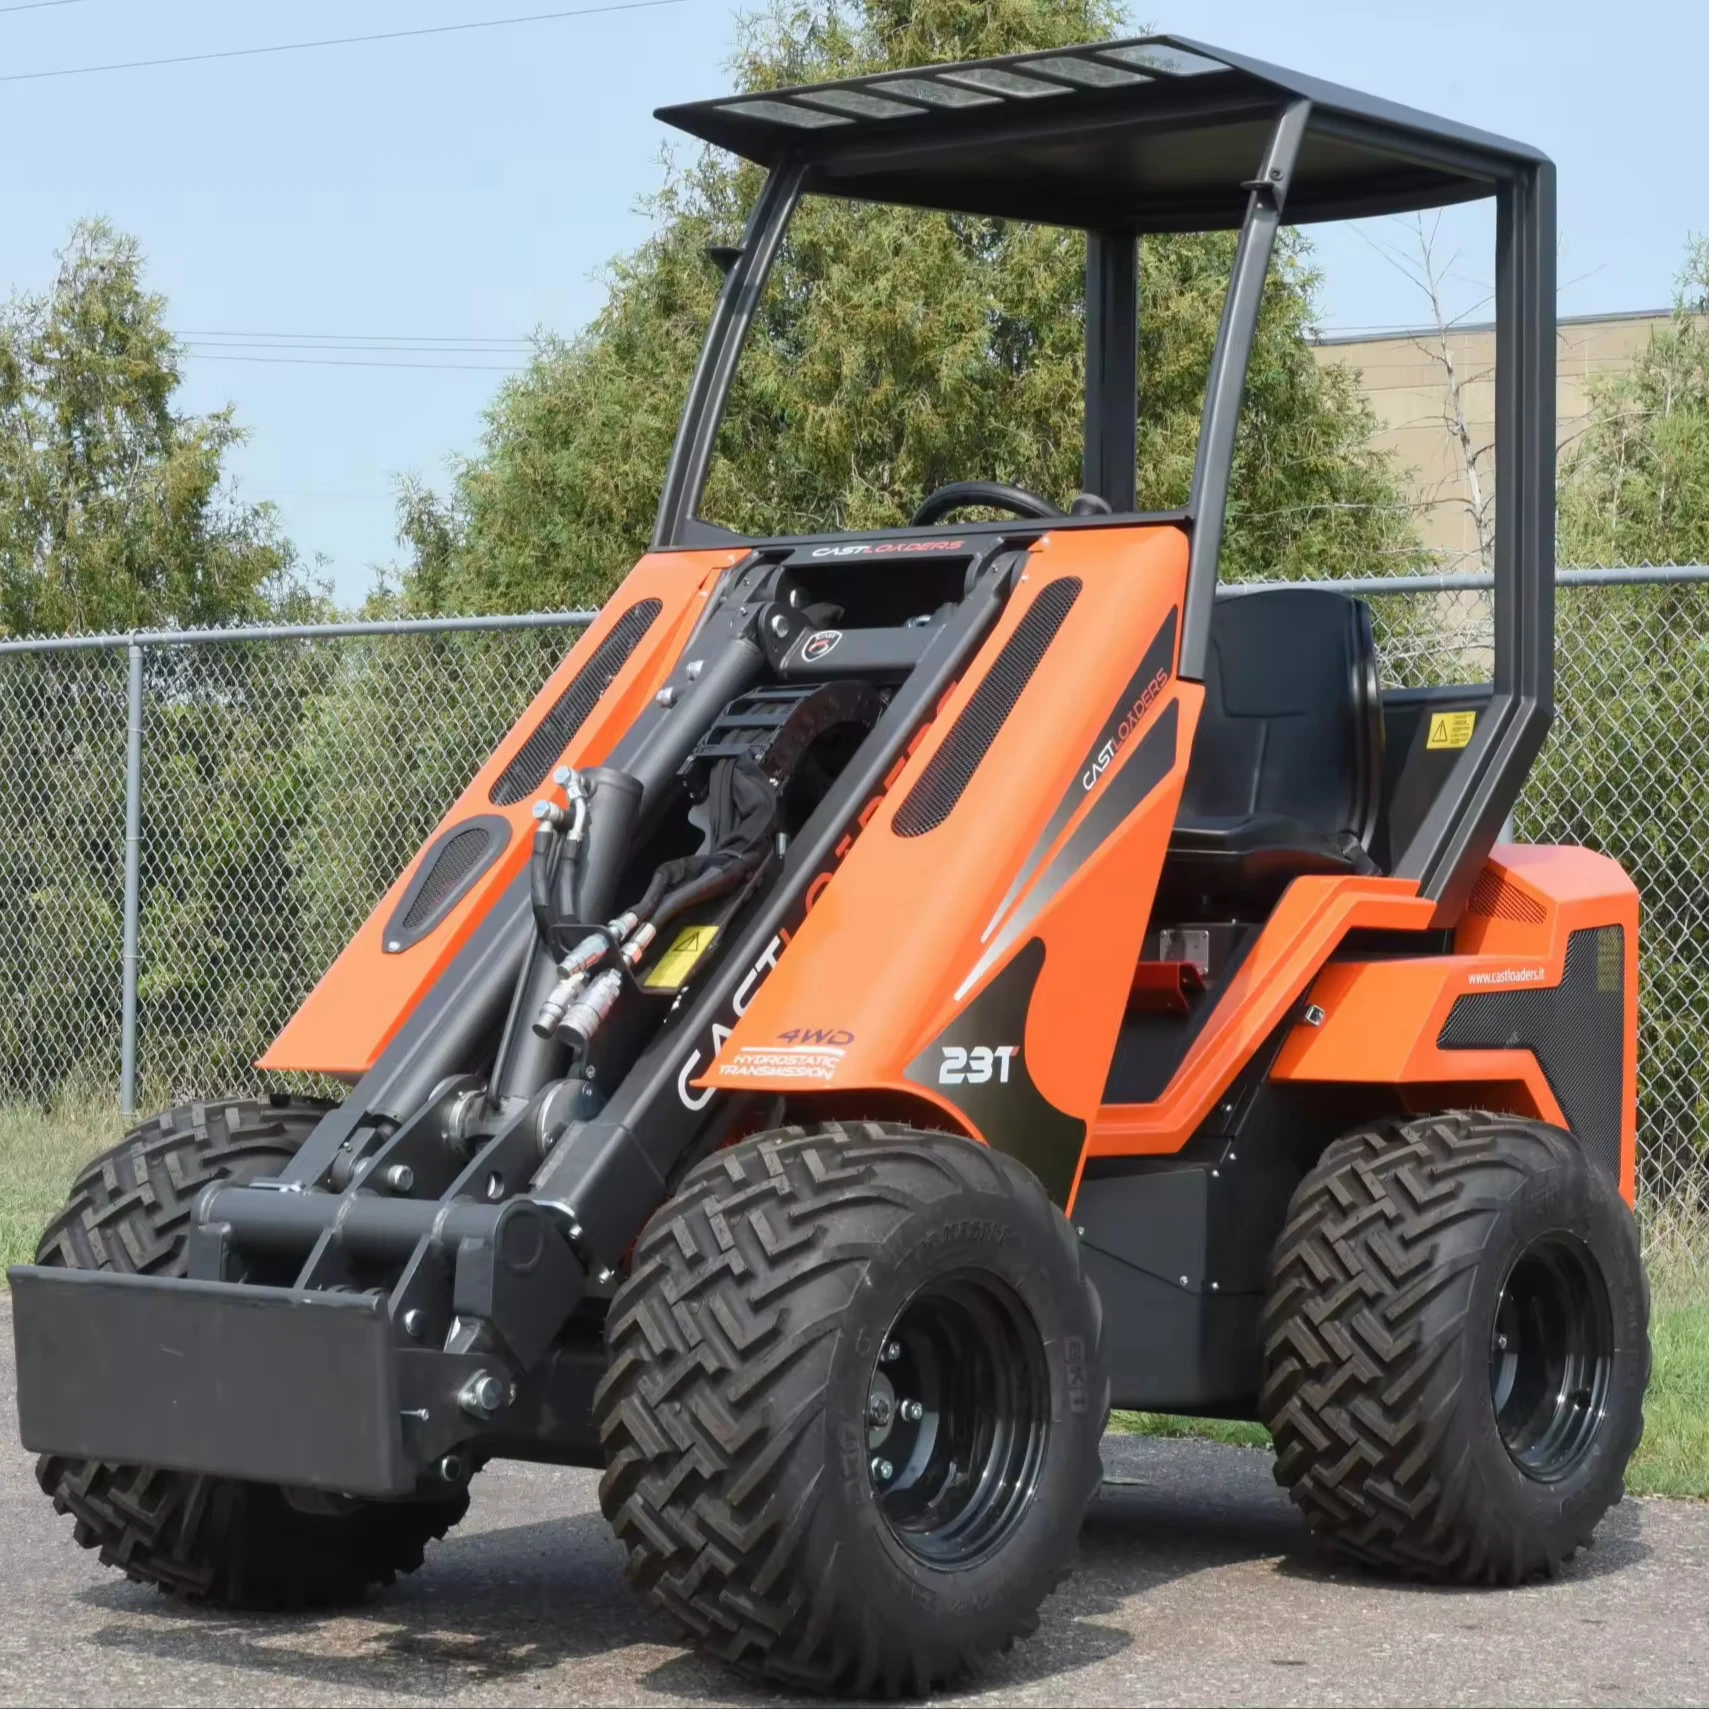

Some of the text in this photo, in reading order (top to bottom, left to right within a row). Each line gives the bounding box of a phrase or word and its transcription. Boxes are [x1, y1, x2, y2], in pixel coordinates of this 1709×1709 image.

[1082, 667, 1168, 791] CASTLOADERS
[1468, 967, 1545, 985] www.castloaders.it
[777, 1029, 855, 1046] 4WD
[733, 1055, 840, 1069] HYDROSTATIC
[719, 1064, 834, 1080] TRANSMISSION
